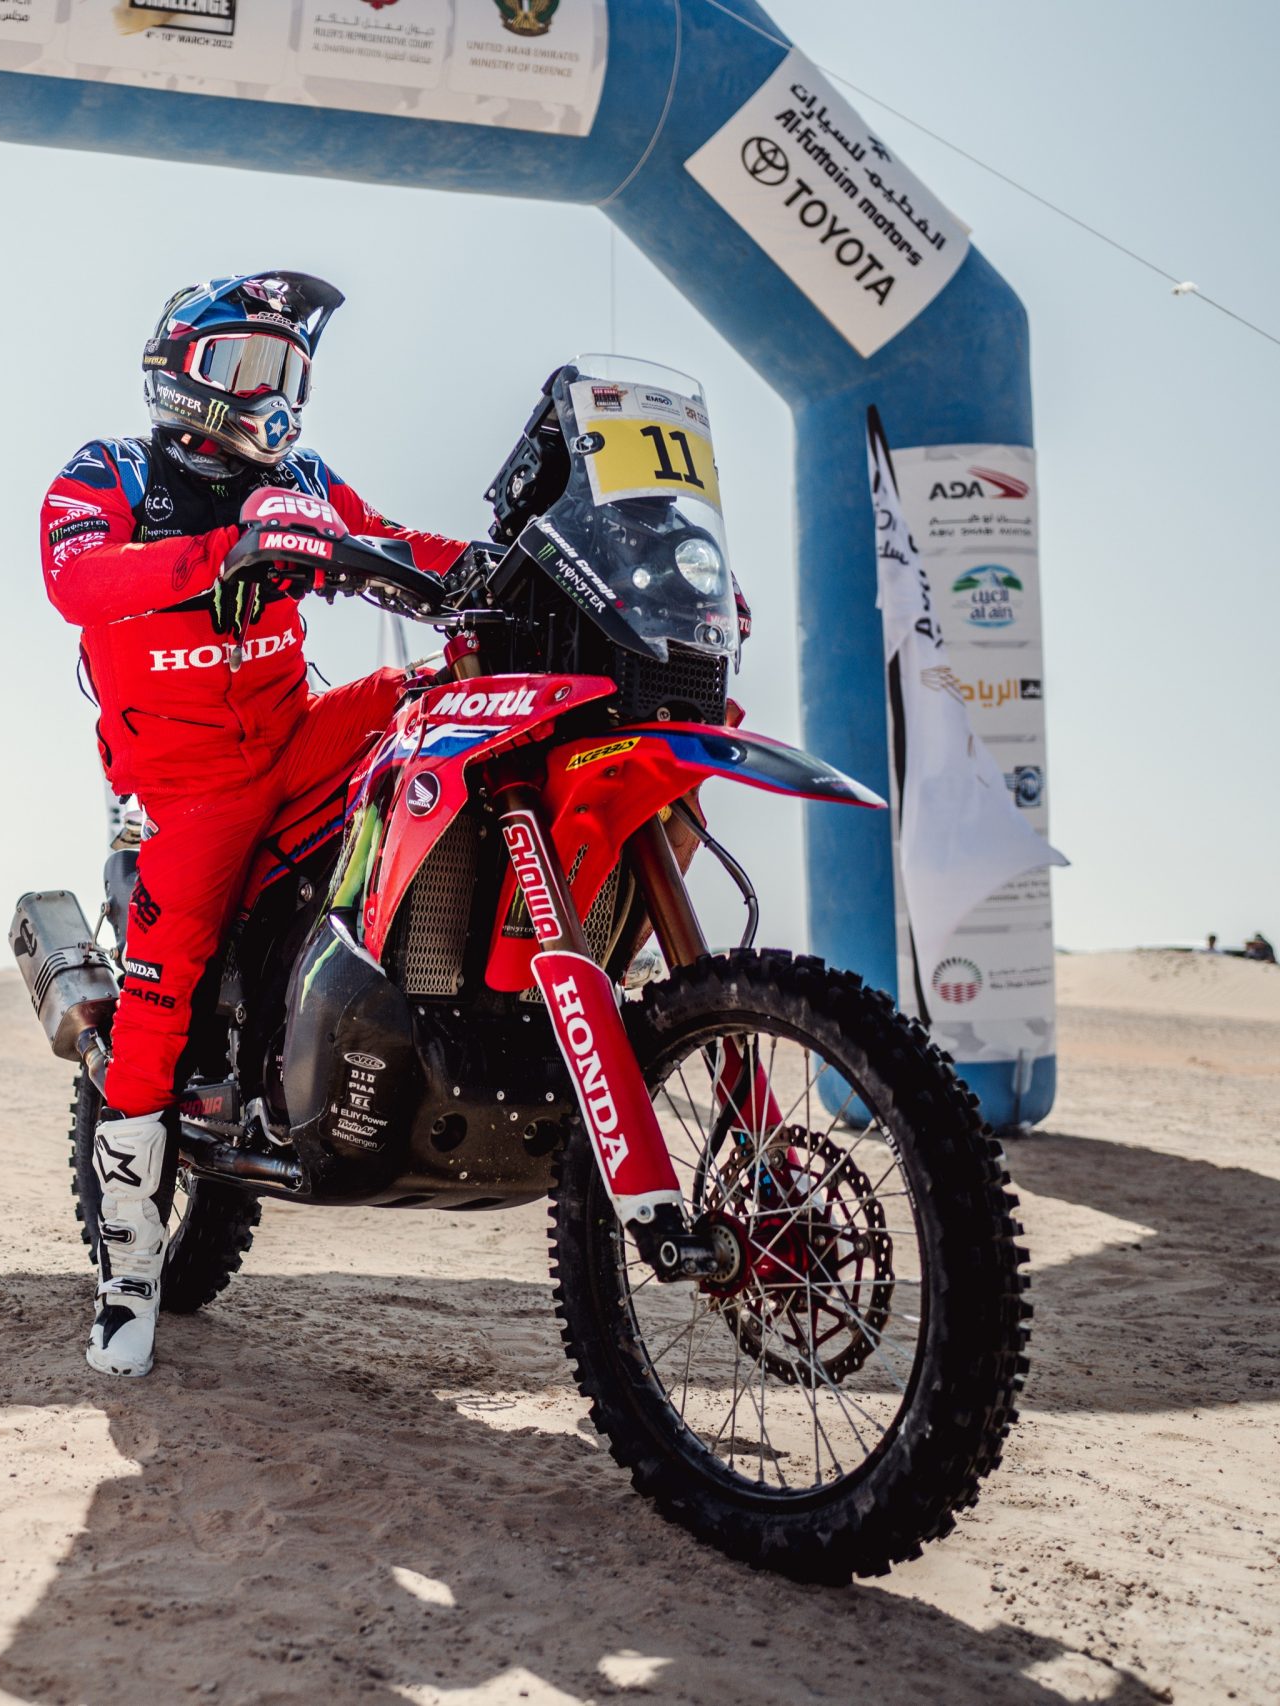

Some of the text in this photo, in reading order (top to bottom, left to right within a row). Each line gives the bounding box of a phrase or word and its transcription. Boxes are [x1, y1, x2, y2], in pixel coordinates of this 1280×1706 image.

[466, 40, 502, 53] UNITED
[506, 45, 531, 56] ARAB
[470, 57, 515, 71] MINISTRY
[789, 82, 867, 163] للسيارات
[775, 108, 924, 267] Al-Futtaim motors
[783, 177, 897, 306] TOYOTA
[157, 384, 202, 413] MONSTER
[640, 425, 705, 490] 11
[928, 481, 985, 500] ADA
[256, 495, 333, 524] GIVI
[265, 534, 327, 556] MOTUL
[555, 558, 606, 613] MONSTER
[555, 574, 590, 609] ENERGY
[150, 628, 297, 672] HONDA
[429, 689, 537, 717] MOTUL
[568, 739, 635, 769] ACERBIS
[408, 799, 431, 809] HONDA
[501, 822, 564, 945] SHOWA
[348, 1081, 376, 1094] PIAA
[552, 975, 630, 1180] HONDA
[362, 1114, 388, 1127] Power
[331, 1128, 378, 1149] ShinDengen
